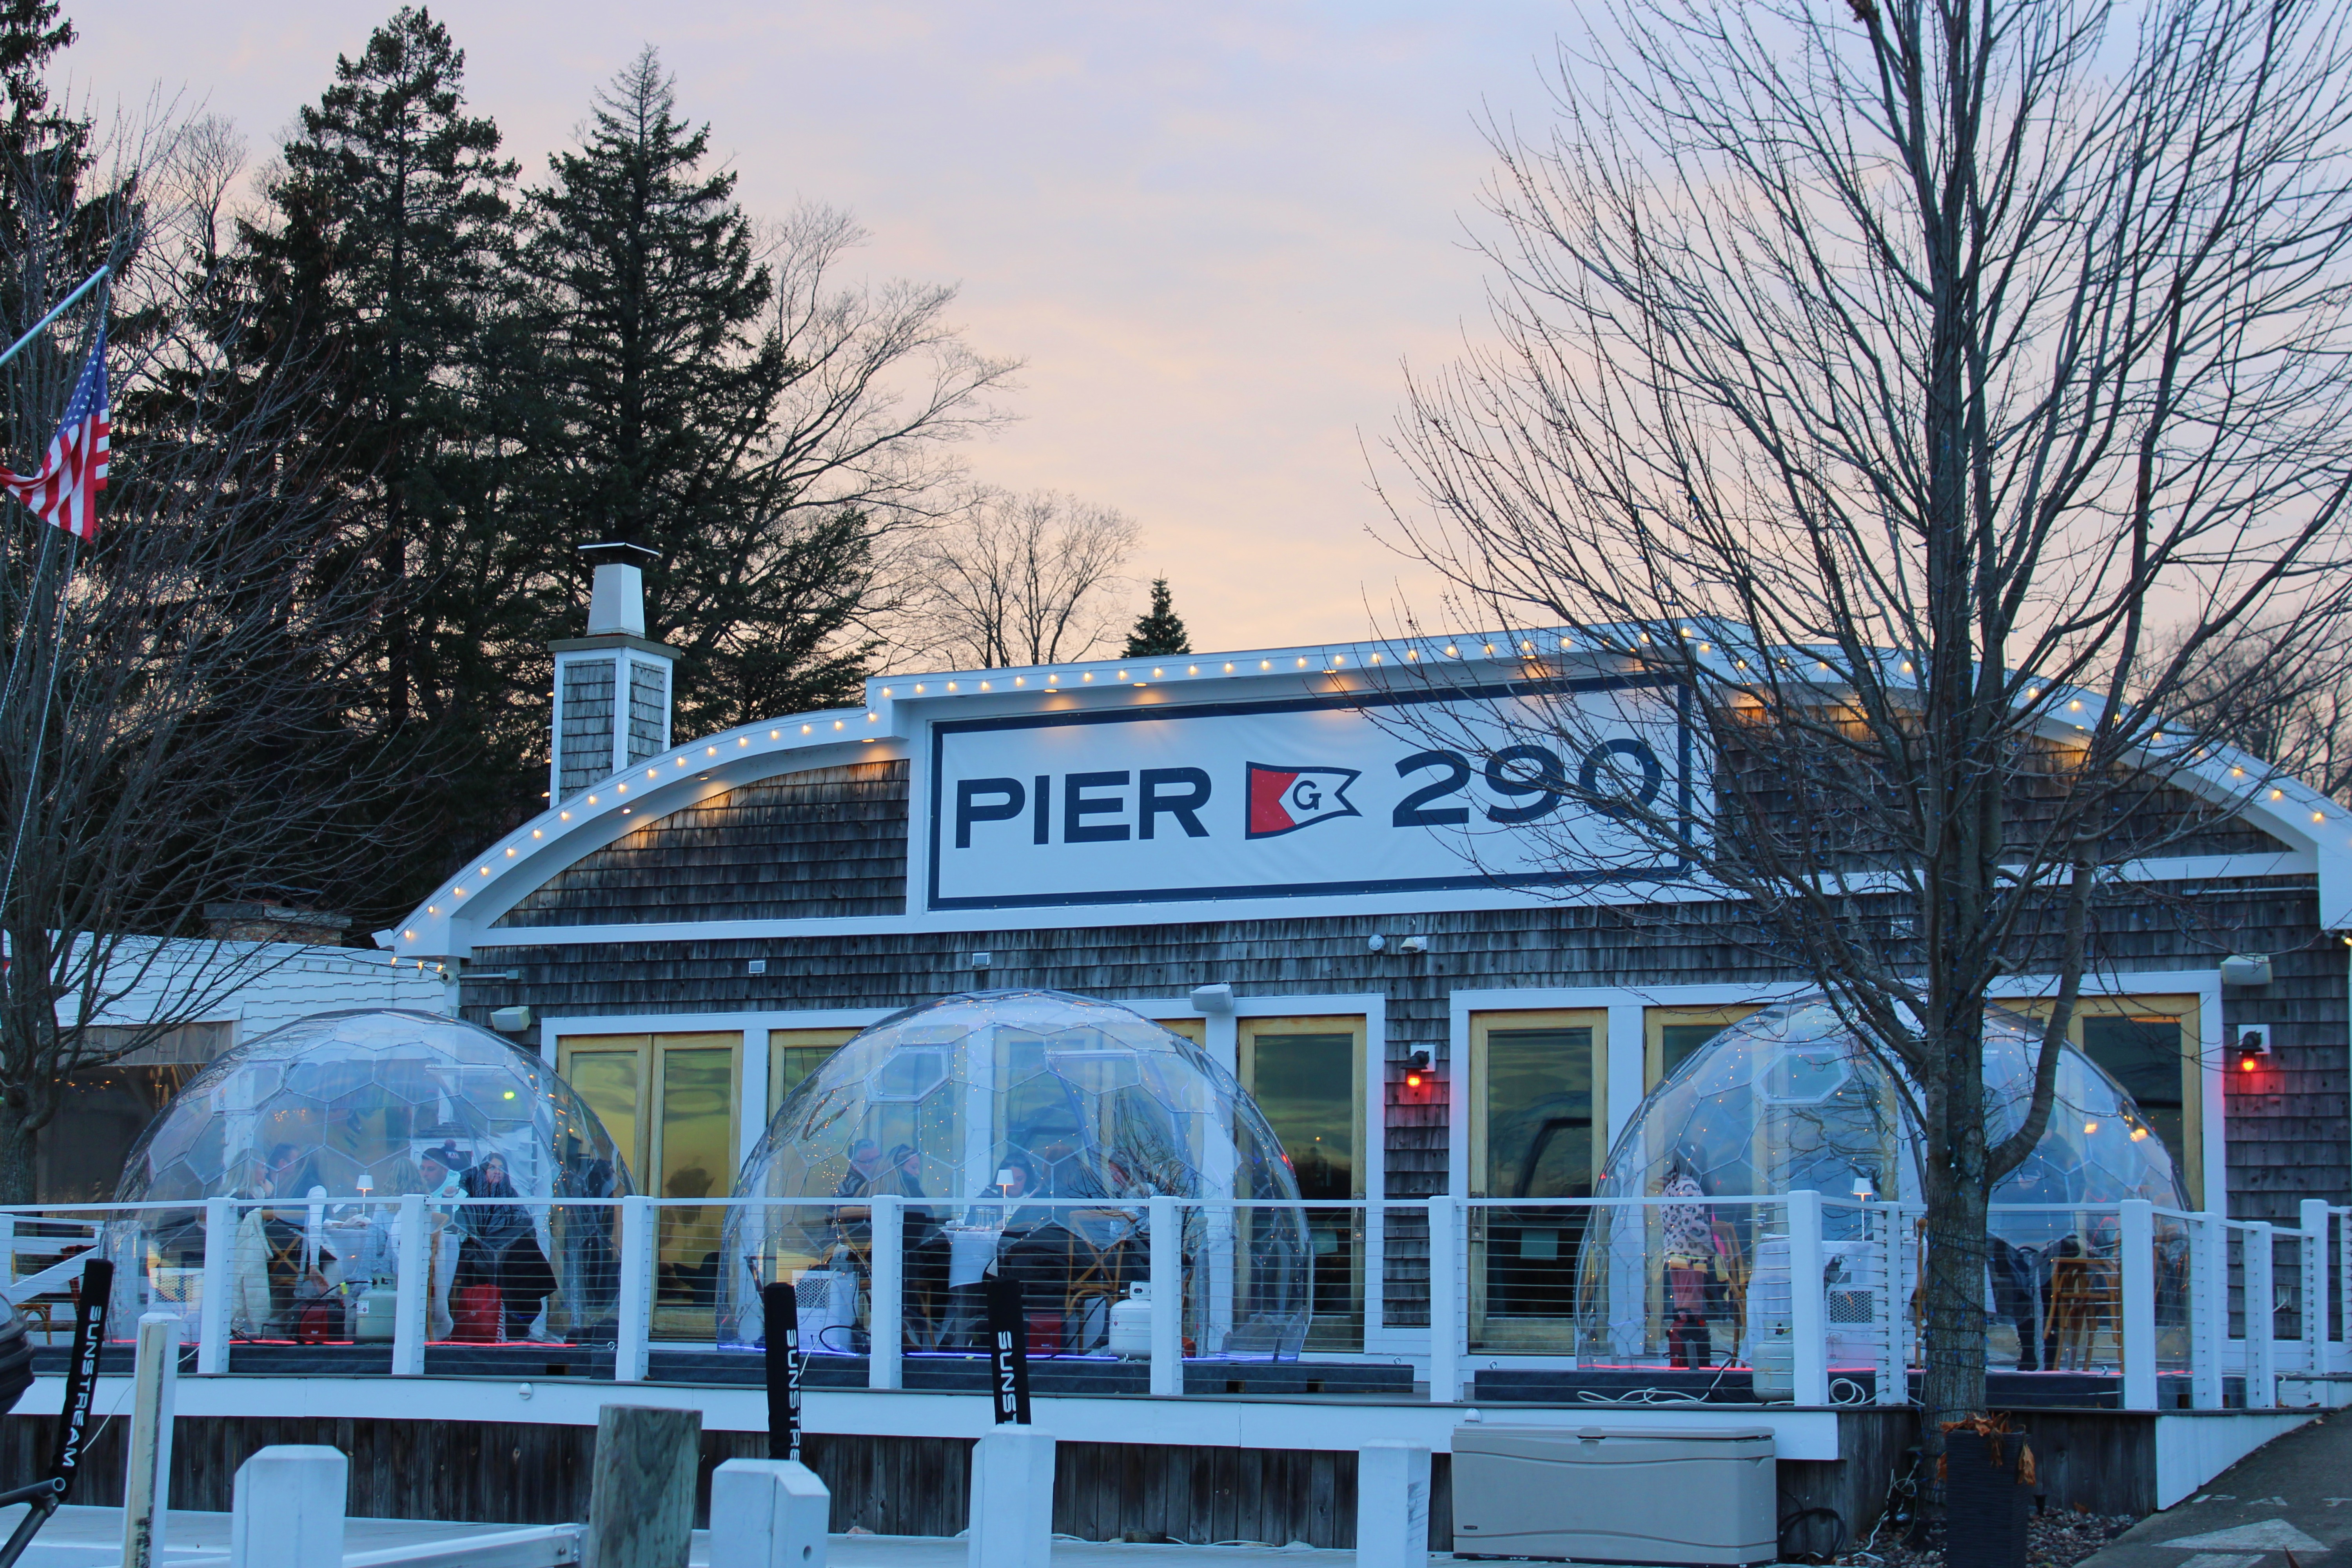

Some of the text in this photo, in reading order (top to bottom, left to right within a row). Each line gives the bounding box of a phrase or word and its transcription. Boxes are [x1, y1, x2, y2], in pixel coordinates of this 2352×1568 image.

[956, 738, 1663, 849] PIER G 290
[62, 1305, 102, 1467] SUNSTREAM
